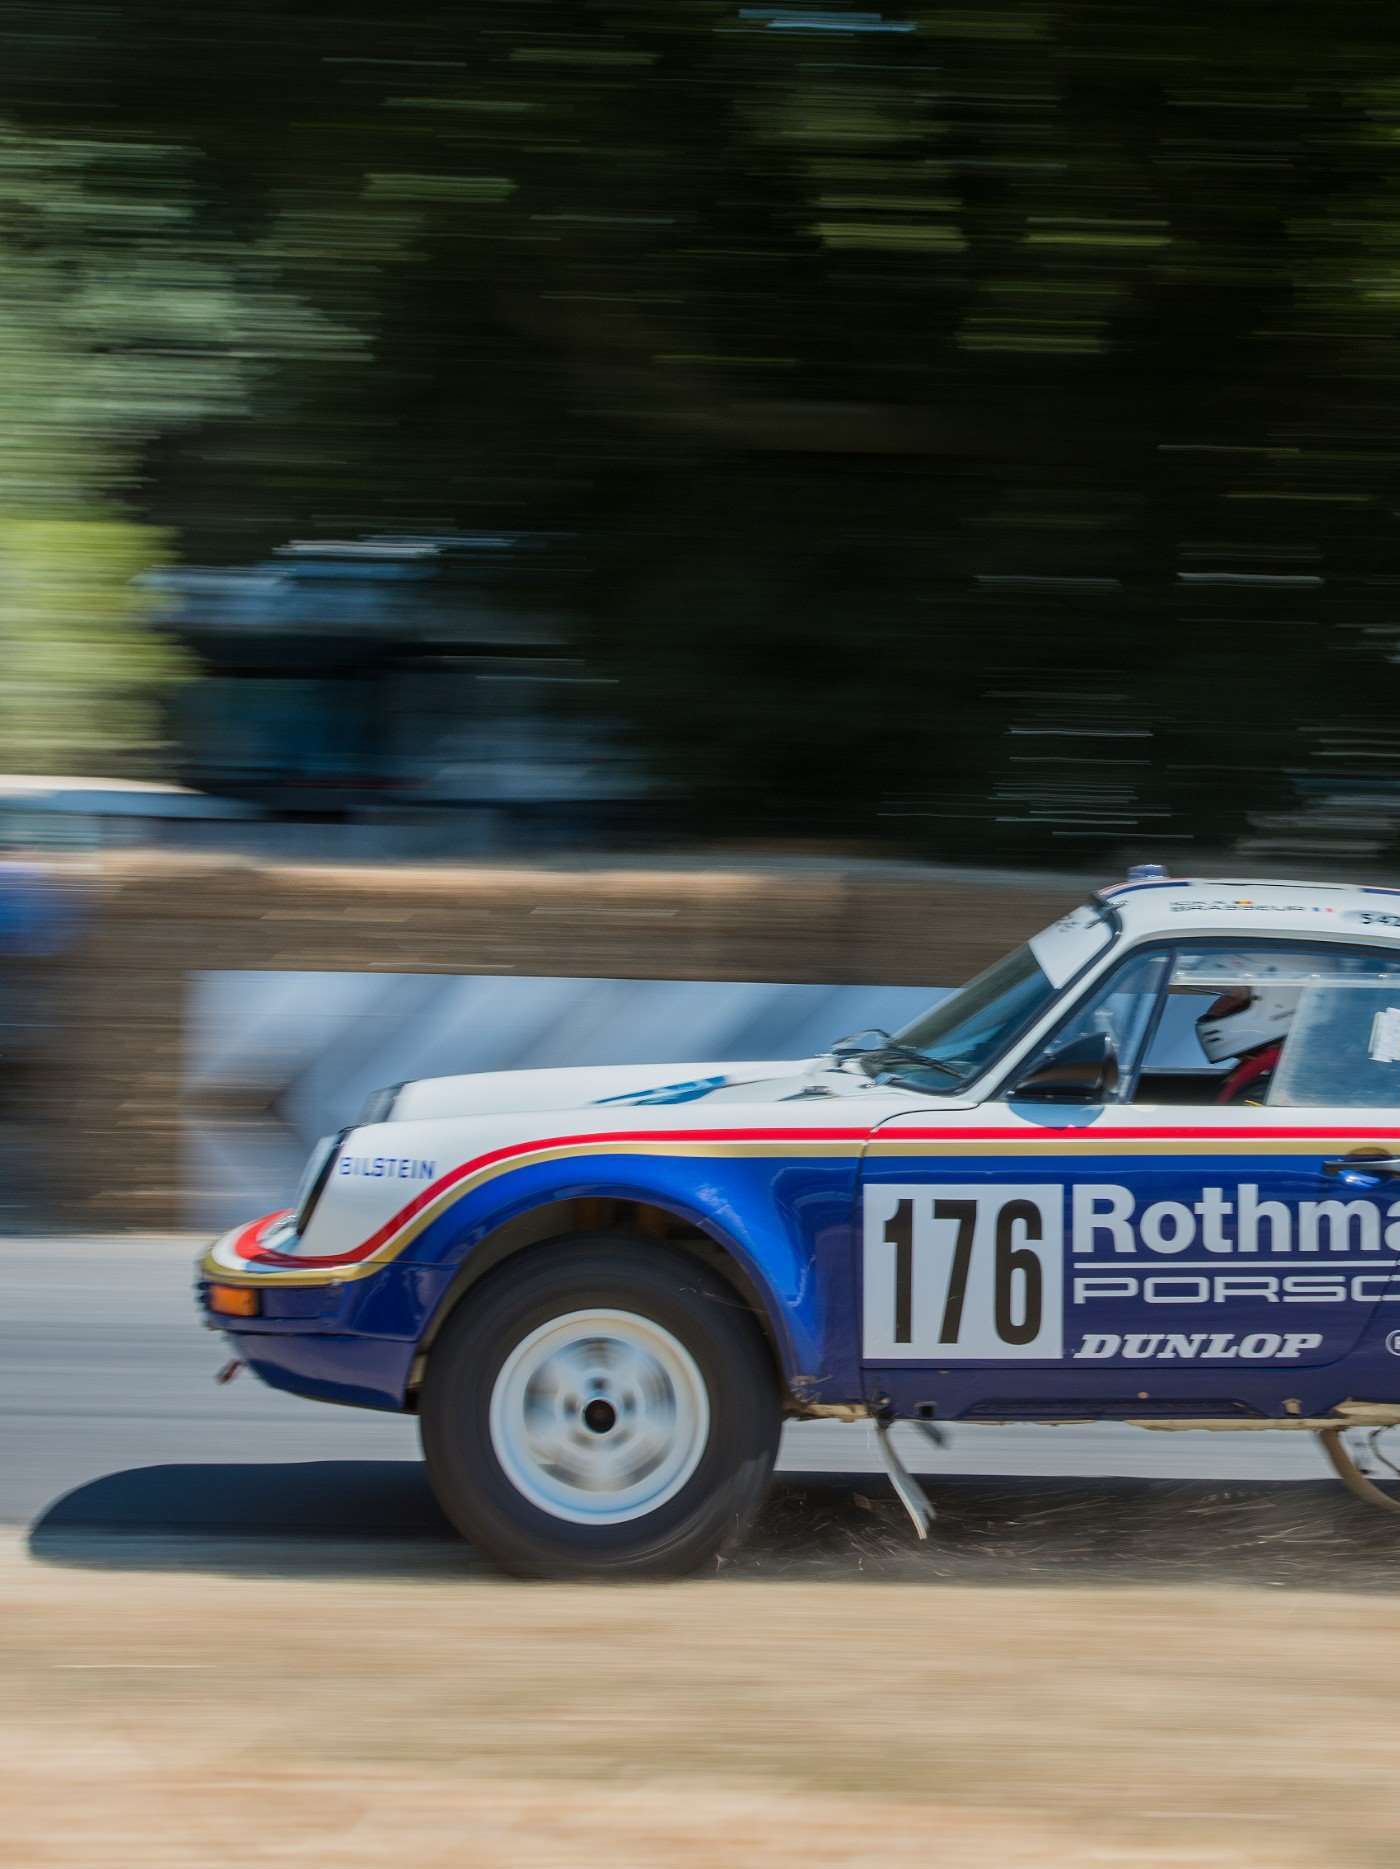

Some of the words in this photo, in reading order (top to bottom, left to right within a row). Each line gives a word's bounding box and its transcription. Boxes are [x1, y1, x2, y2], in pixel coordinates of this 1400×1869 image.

[340, 1157, 436, 1179] BILSTEIN
[883, 1198, 1043, 1346] 176
[1072, 1333, 1324, 1360] DUNLOP
